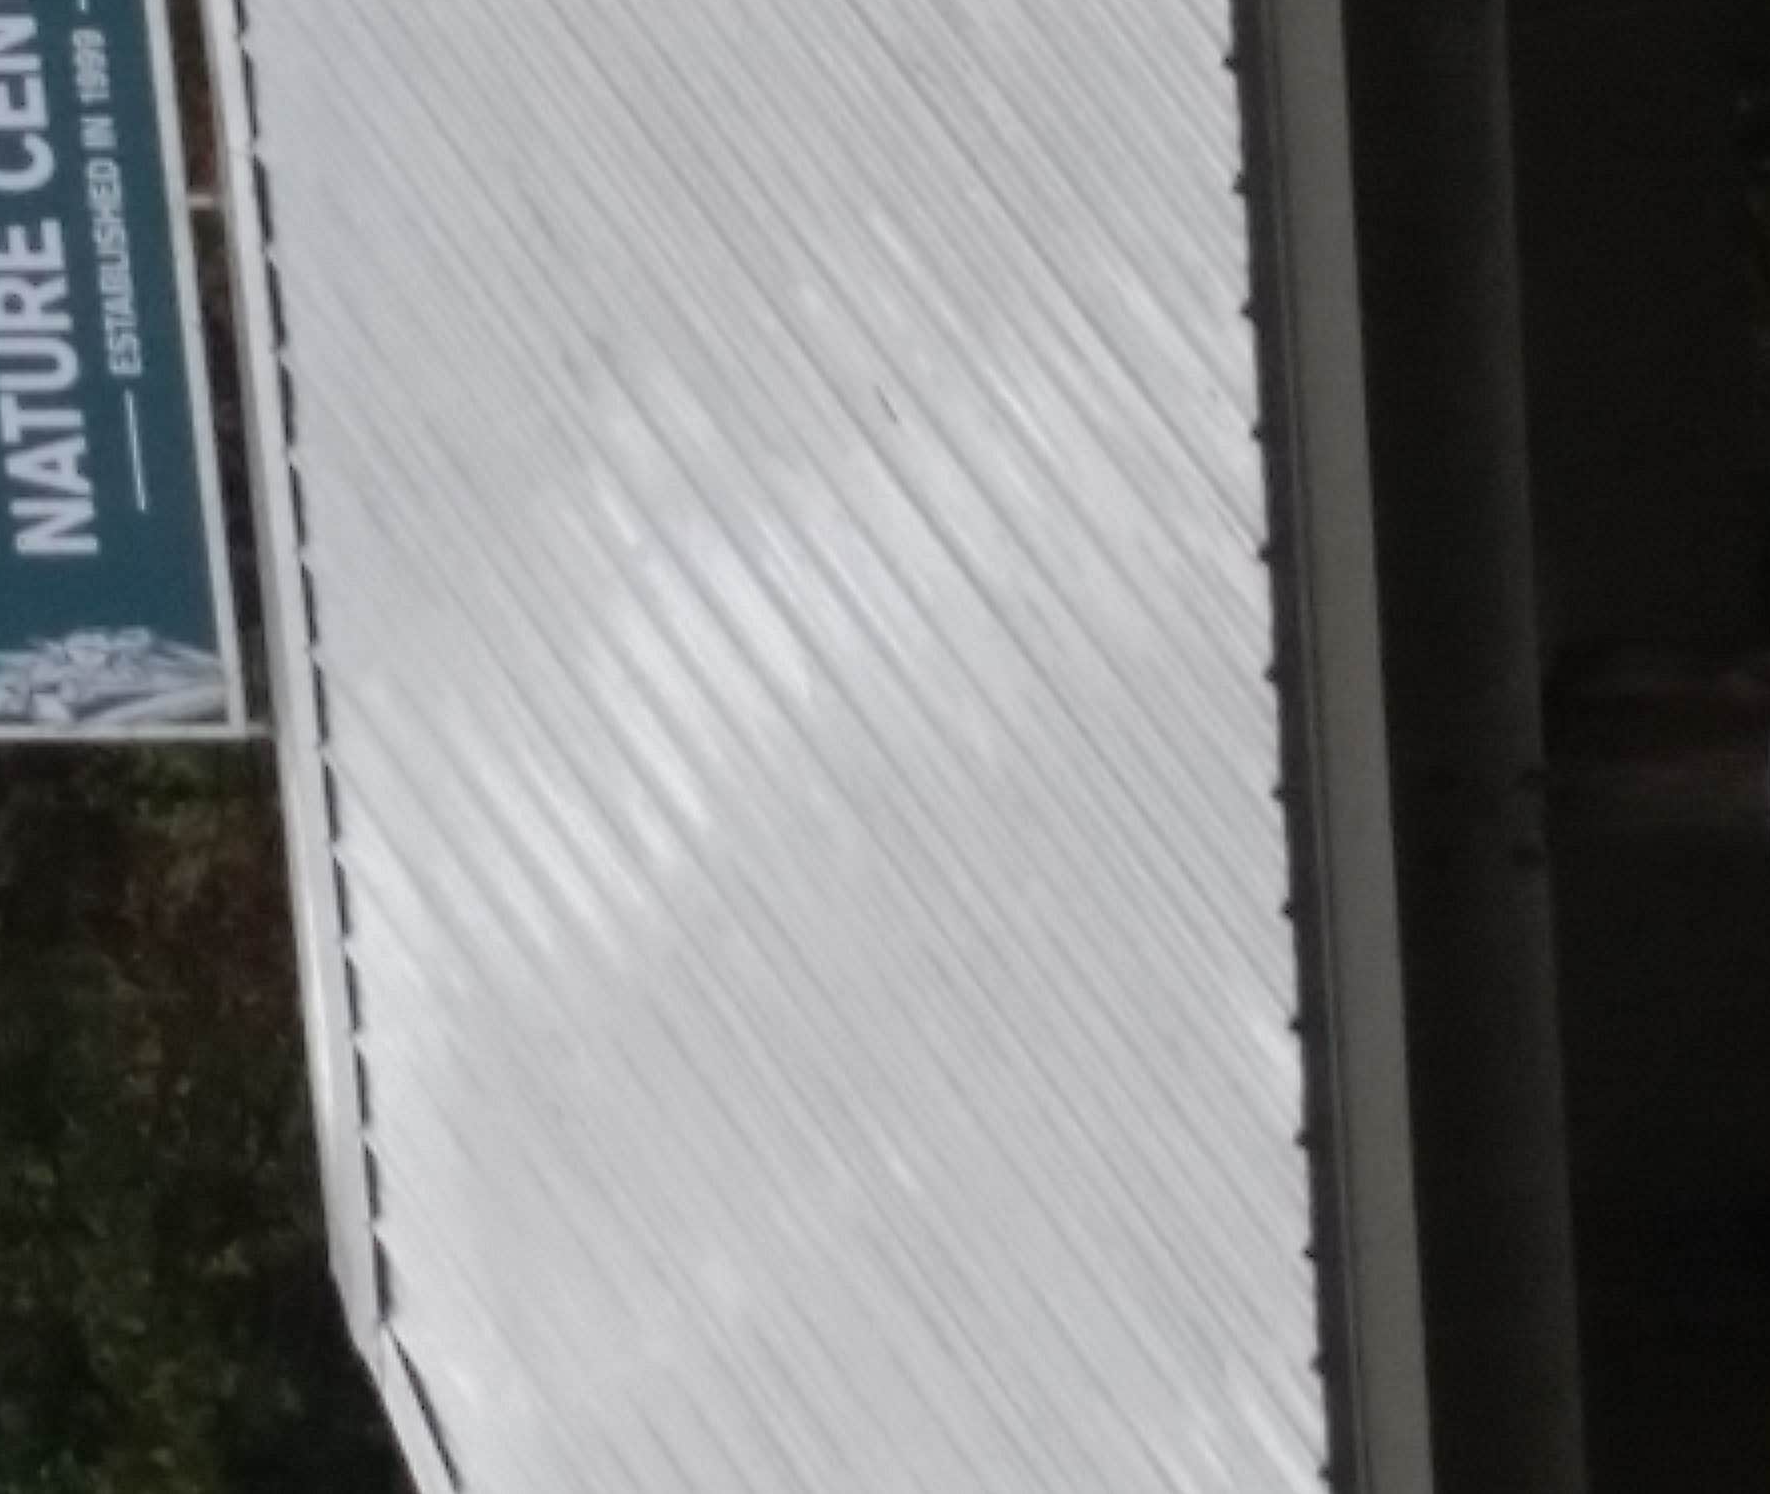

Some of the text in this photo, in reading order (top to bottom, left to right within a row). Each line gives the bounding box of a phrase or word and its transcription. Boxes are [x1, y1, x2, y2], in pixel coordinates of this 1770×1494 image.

[72, 28, 142, 376] ESTABLISHED IN 1999
